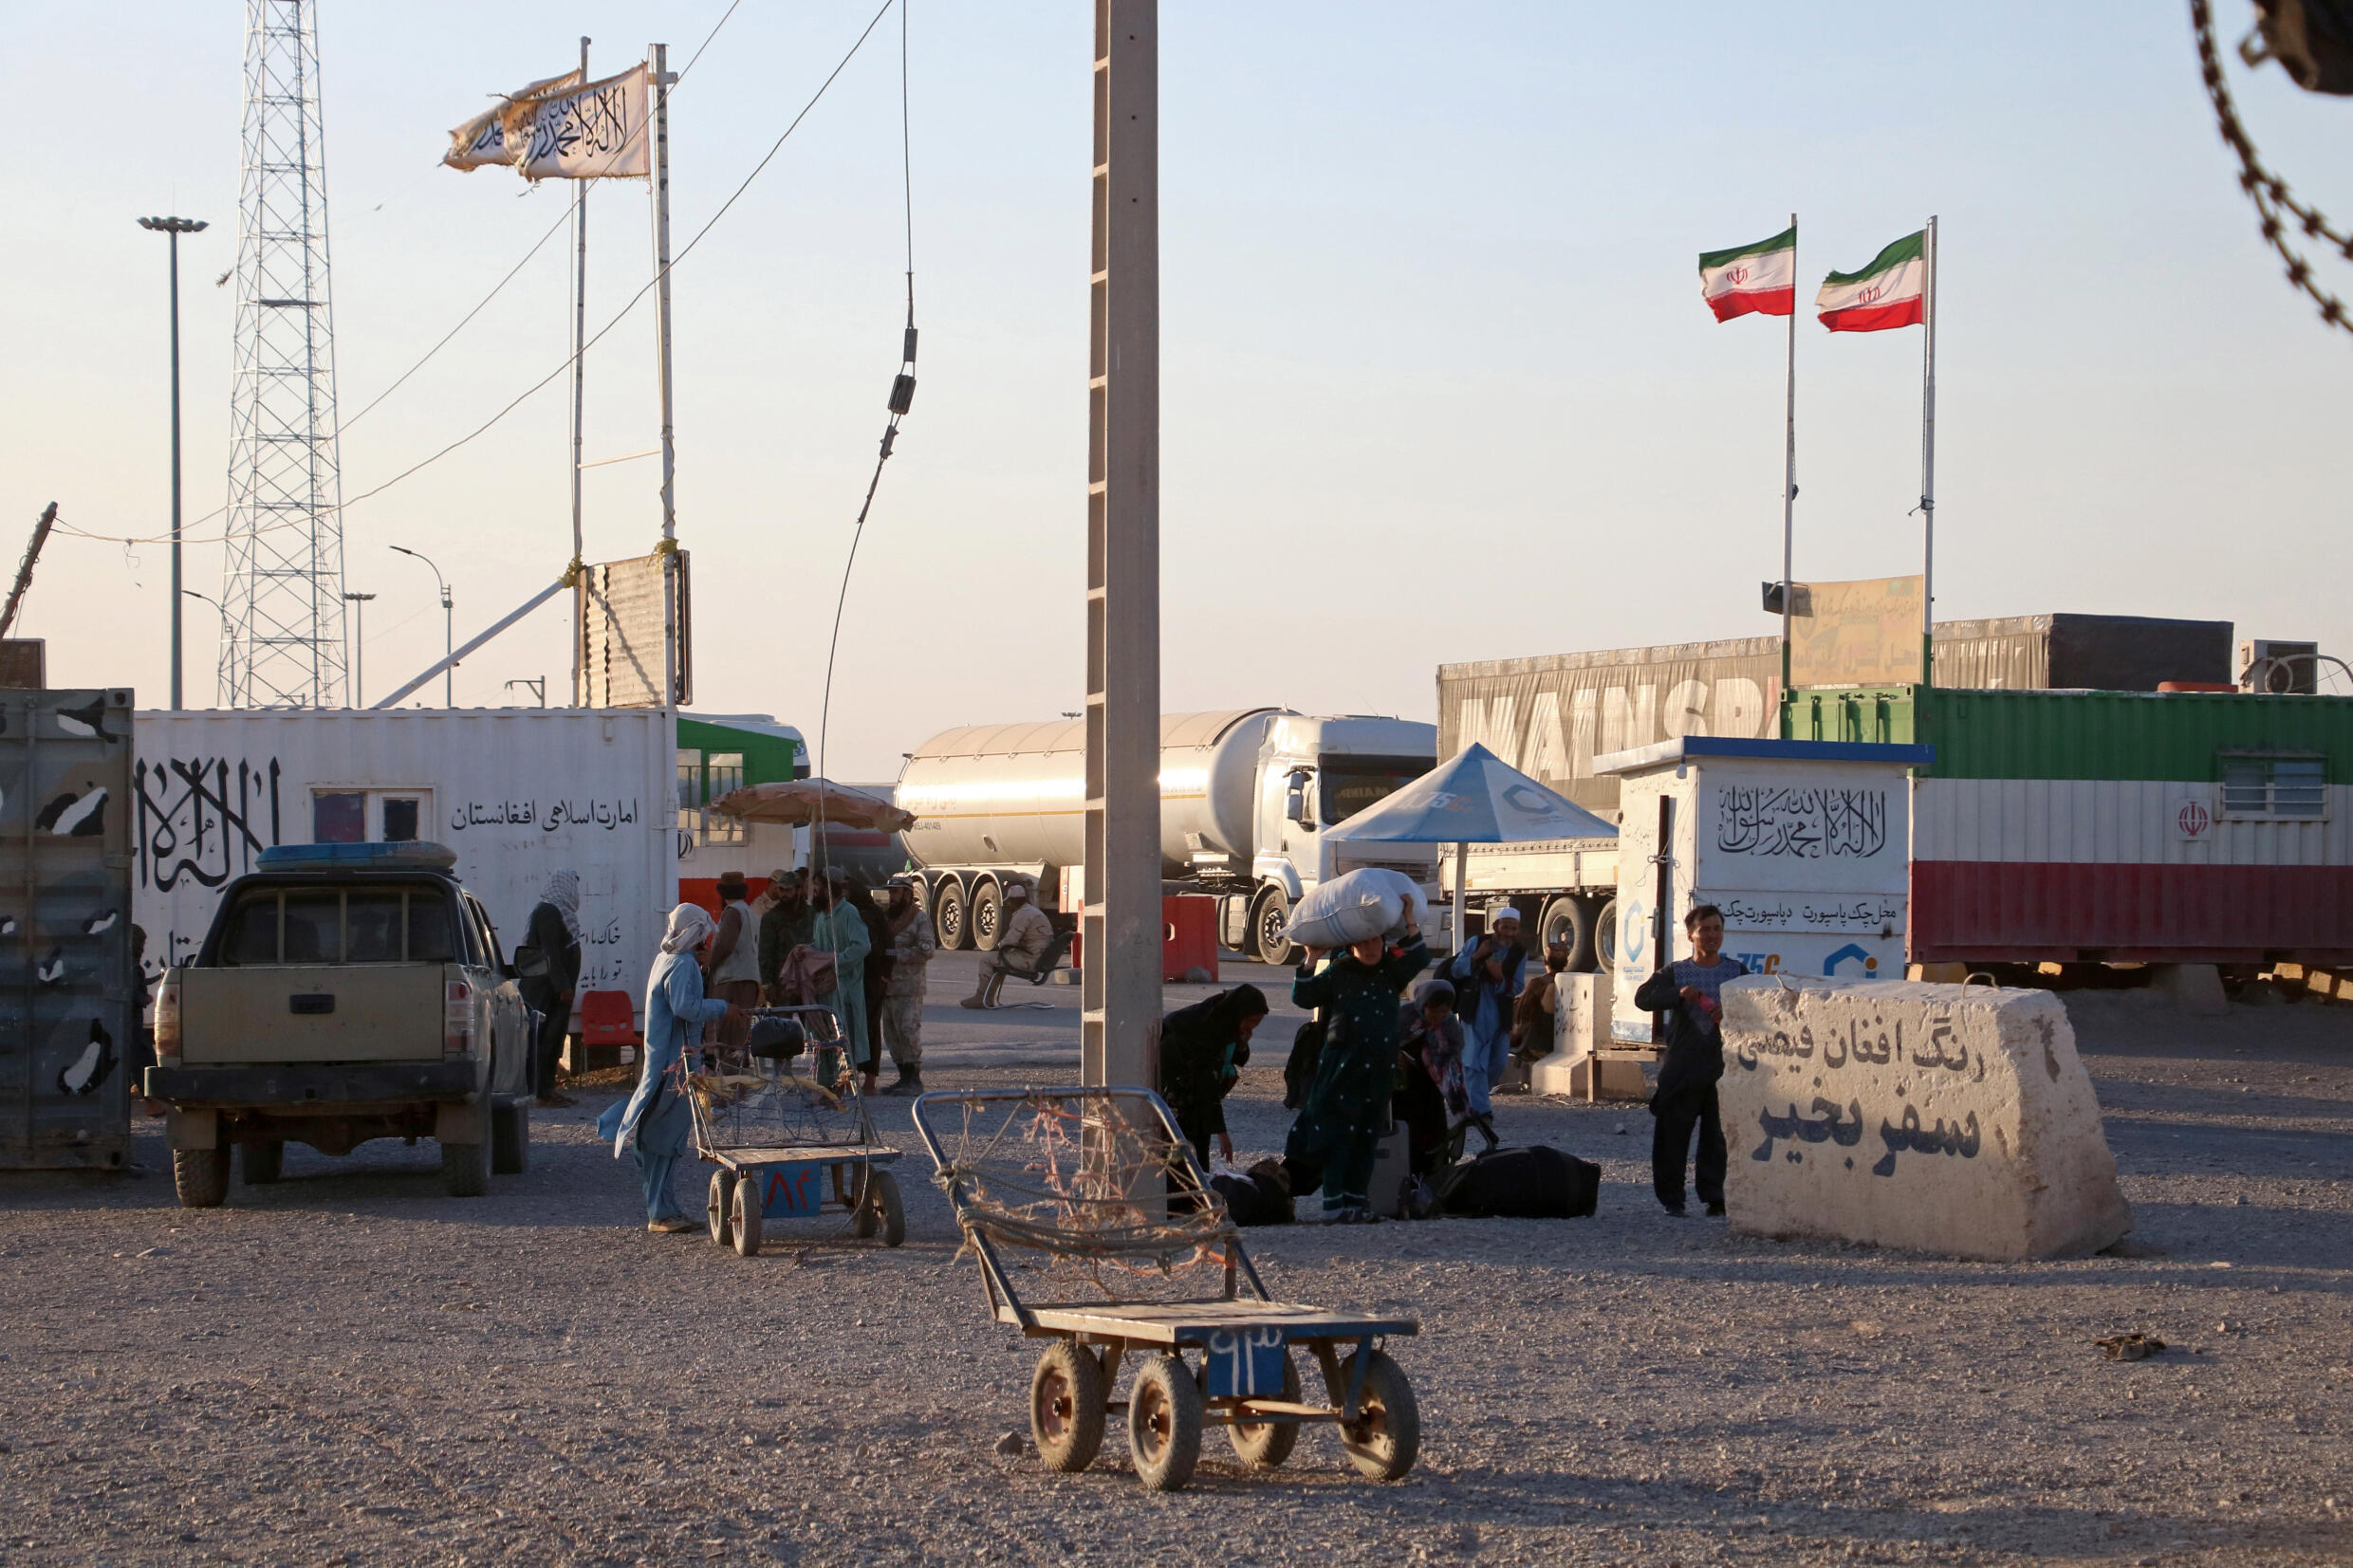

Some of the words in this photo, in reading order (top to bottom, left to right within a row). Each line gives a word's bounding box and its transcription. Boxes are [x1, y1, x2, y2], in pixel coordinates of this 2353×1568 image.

[451, 798, 537, 831] افغانستان
[541, 798, 596, 832] اسلامی
[596, 798, 639, 831] امارت
[1723, 900, 1745, 926] چک
[1746, 902, 1786, 926] پاسپورت
[1803, 902, 1847, 927] پاسپورت
[1849, 902, 1873, 928] چک
[1824, 1014, 1903, 1070] افغان
[1751, 1076, 1863, 1171] بخیر
[1872, 1084, 1982, 1178] سفر
